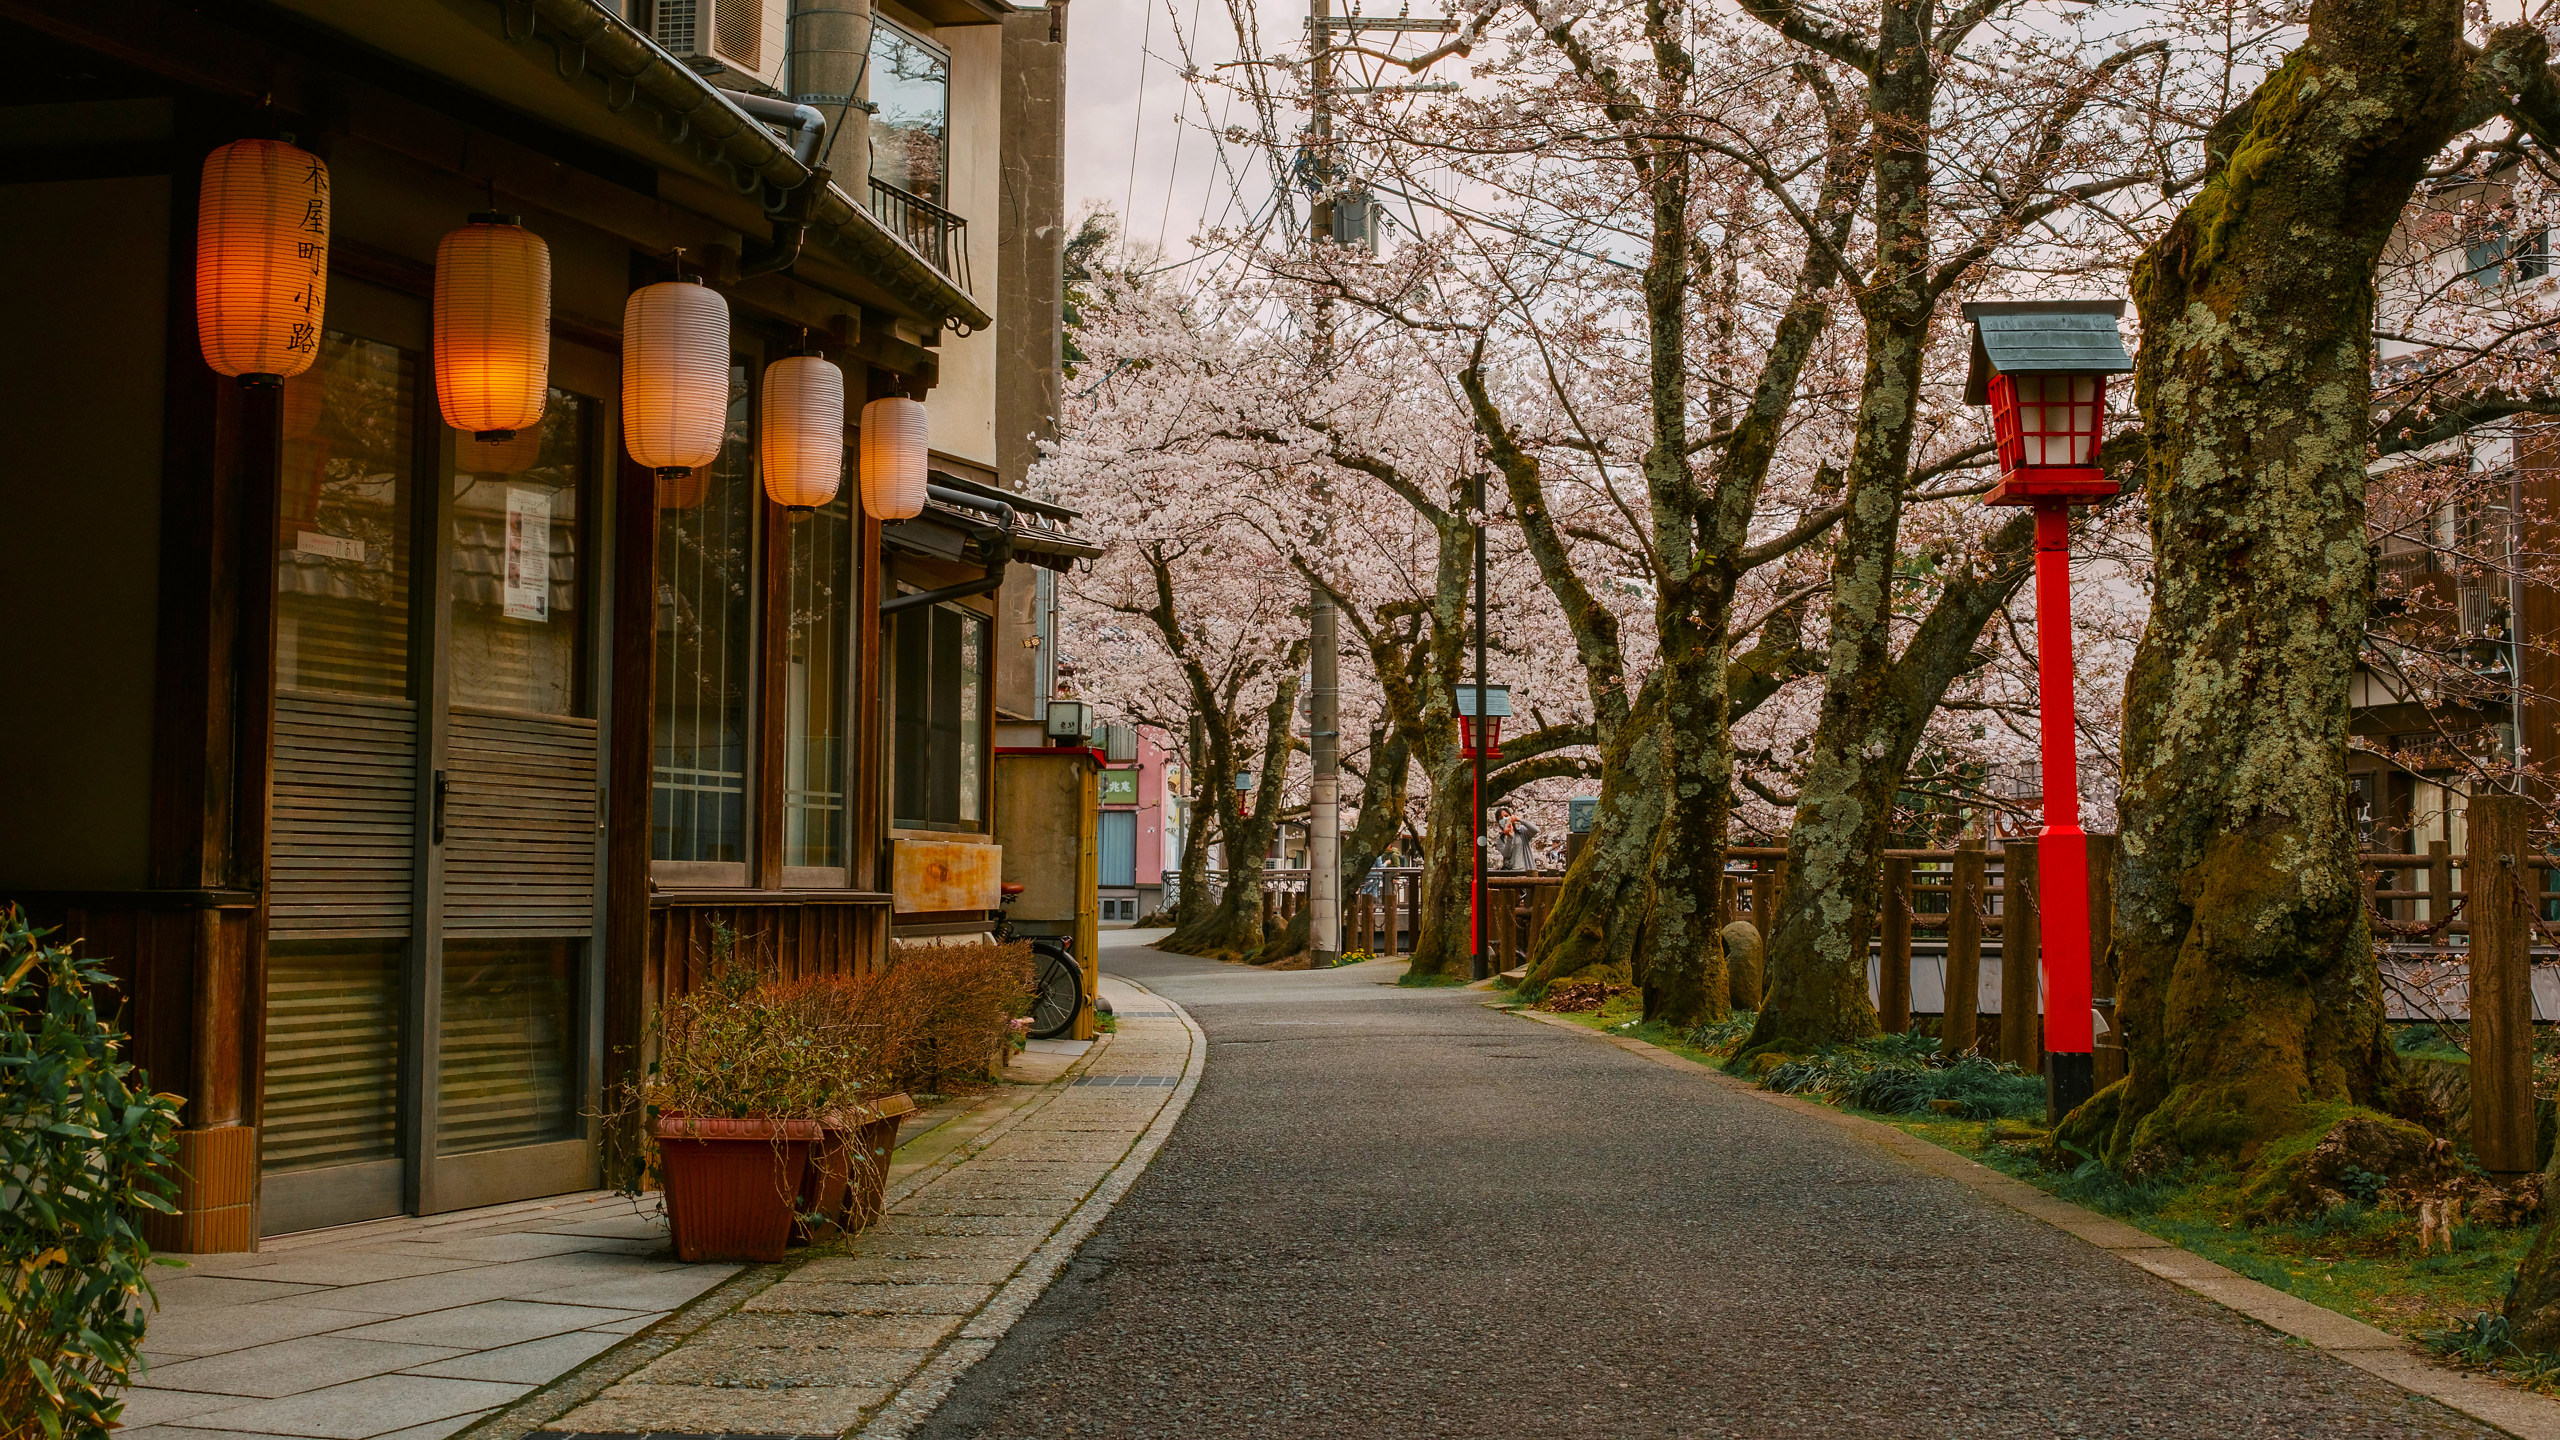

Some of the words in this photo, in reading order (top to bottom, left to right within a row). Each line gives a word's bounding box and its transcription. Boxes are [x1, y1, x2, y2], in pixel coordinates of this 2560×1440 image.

[287, 156, 328, 354] 木屋町小路
[1098, 780, 1132, 793] 兆庵
